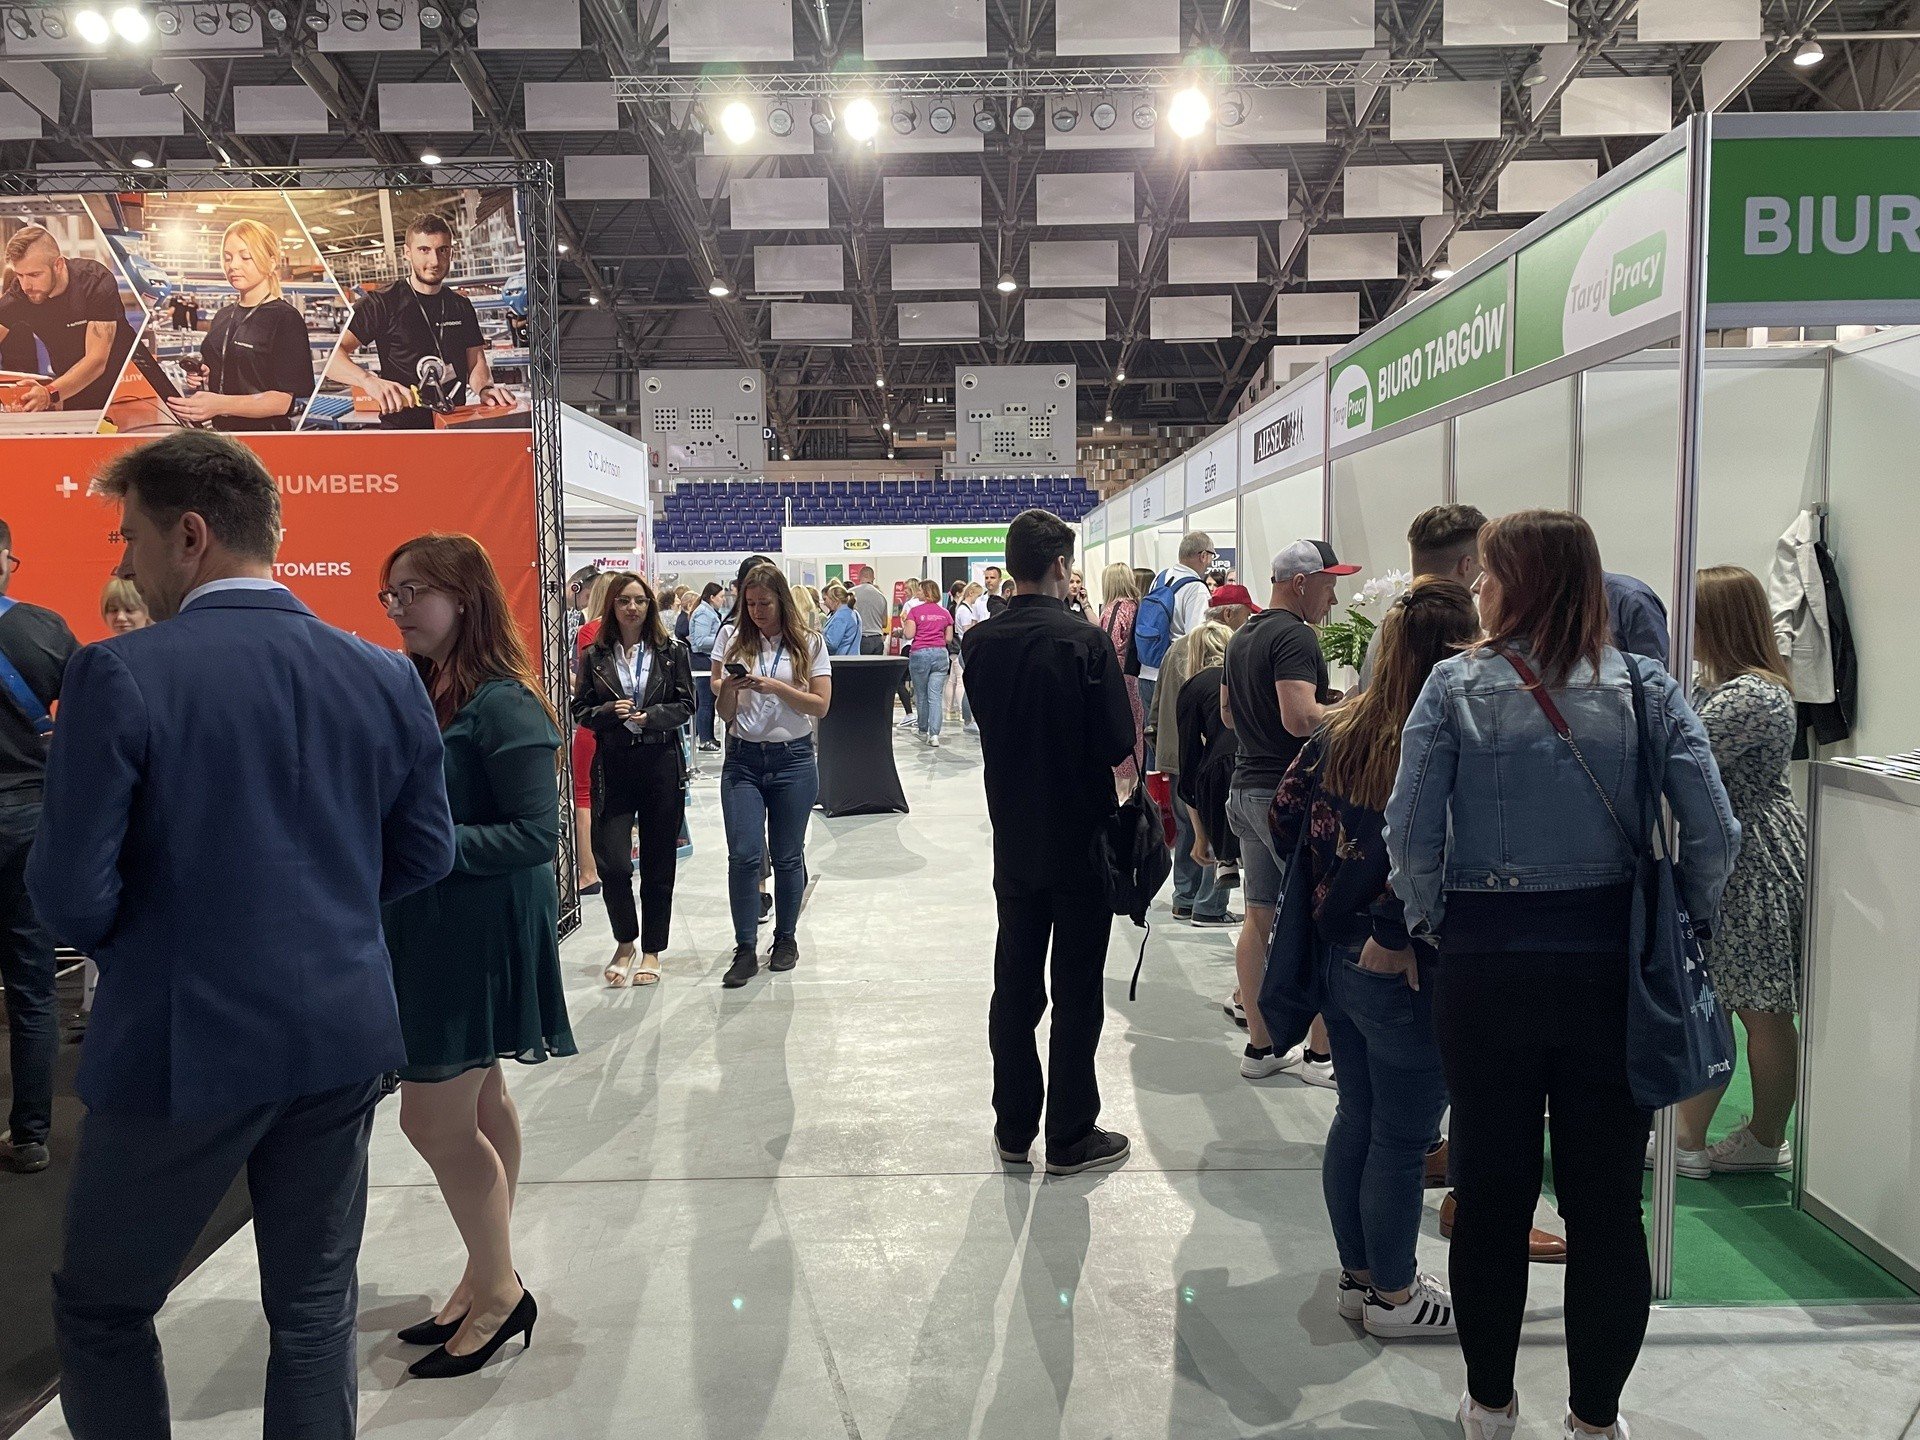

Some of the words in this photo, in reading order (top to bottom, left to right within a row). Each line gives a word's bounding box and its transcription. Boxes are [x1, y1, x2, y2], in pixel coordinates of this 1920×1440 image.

[1571, 269, 1608, 314] Targi
[1612, 251, 1661, 296] Pracy
[1378, 348, 1422, 402] BIURO
[1425, 303, 1505, 380] TARGÓW
[1333, 402, 1347, 425] Targi
[1348, 397, 1366, 418] Pracy
[1257, 419, 1287, 460] AIESEC
[935, 536, 993, 544] ZAPRASZAMY
[273, 562, 352, 577] TOMERS
[688, 559, 713, 567] GROUP
